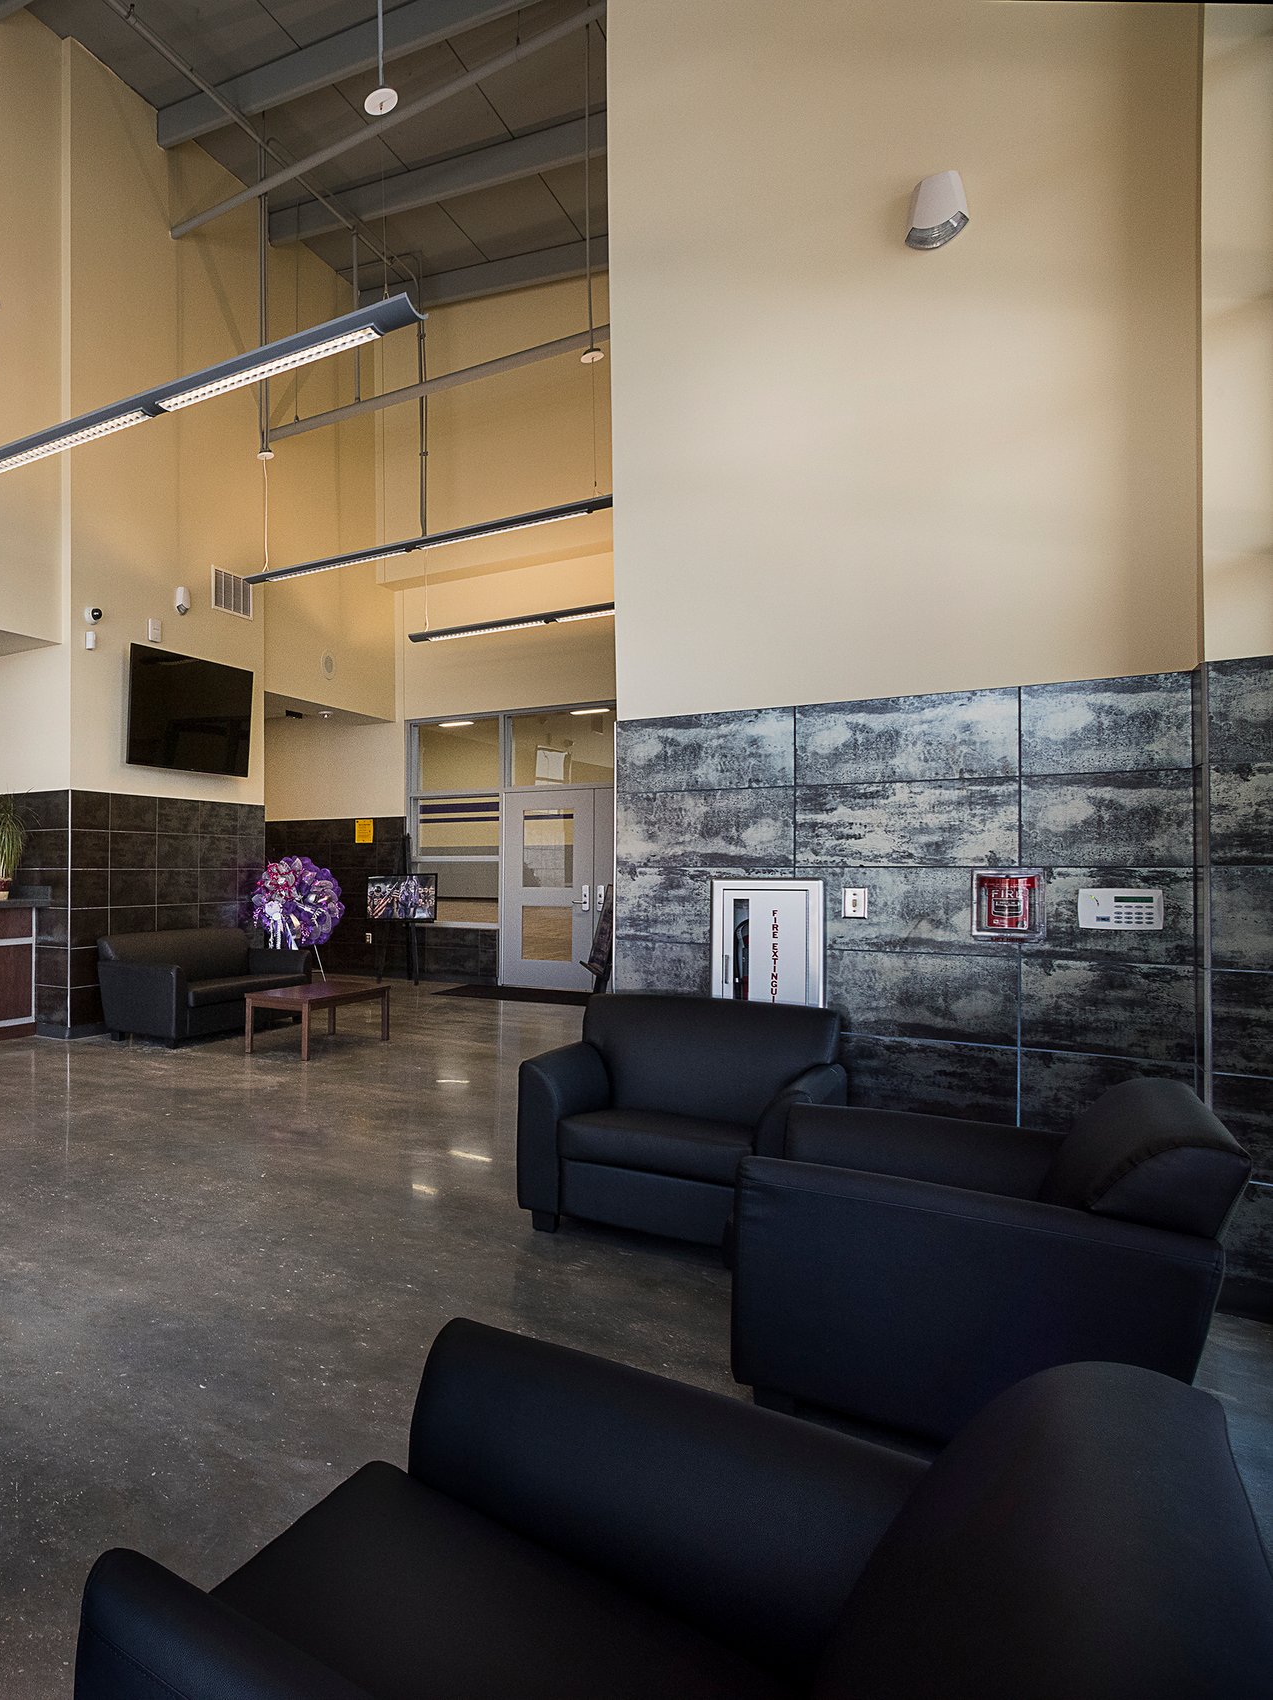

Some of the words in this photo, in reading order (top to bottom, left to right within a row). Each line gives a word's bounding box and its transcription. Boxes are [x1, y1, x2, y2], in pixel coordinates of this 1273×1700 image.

[991, 889, 1023, 898] FIRE
[771, 909, 779, 939] FIRE
[770, 942, 779, 1003] EXTINGUI
